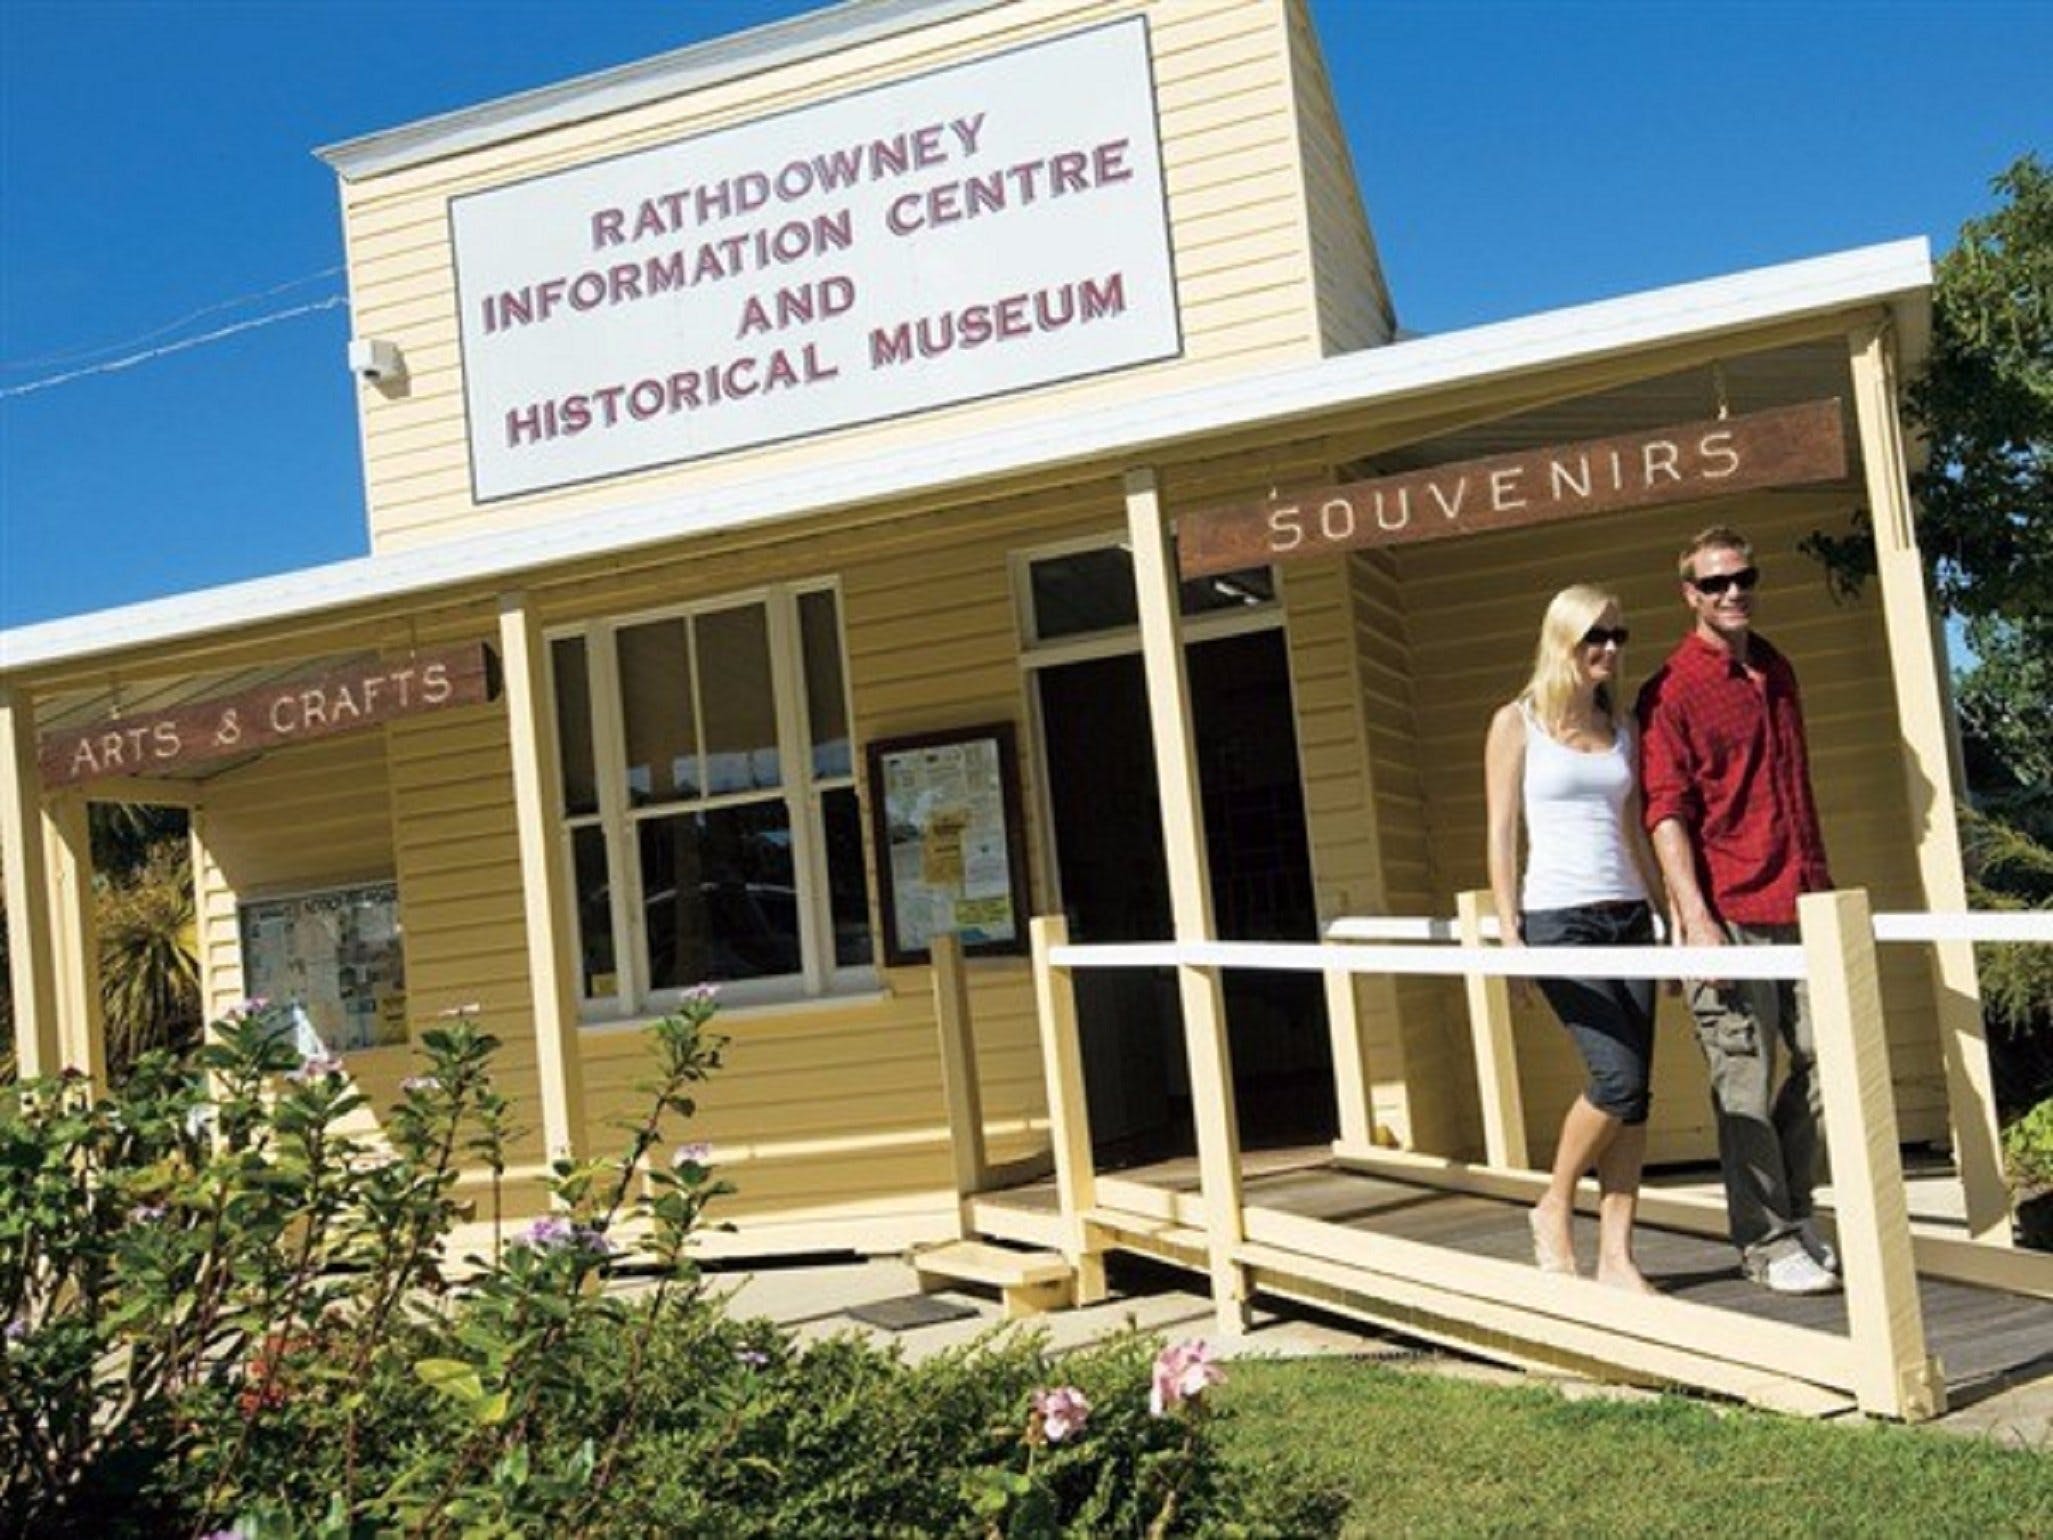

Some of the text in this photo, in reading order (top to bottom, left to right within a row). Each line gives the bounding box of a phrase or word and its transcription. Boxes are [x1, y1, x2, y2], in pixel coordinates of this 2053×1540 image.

[481, 139, 1133, 334] INFORMATION CENTRE
[590, 113, 986, 251] RATHDOWNEY
[505, 273, 1128, 448] HISTORICAL MUSEUM
[736, 276, 855, 339] AND
[1268, 431, 1740, 553] SOUVENIRS
[71, 664, 452, 777] ARTS & CRAFTS
